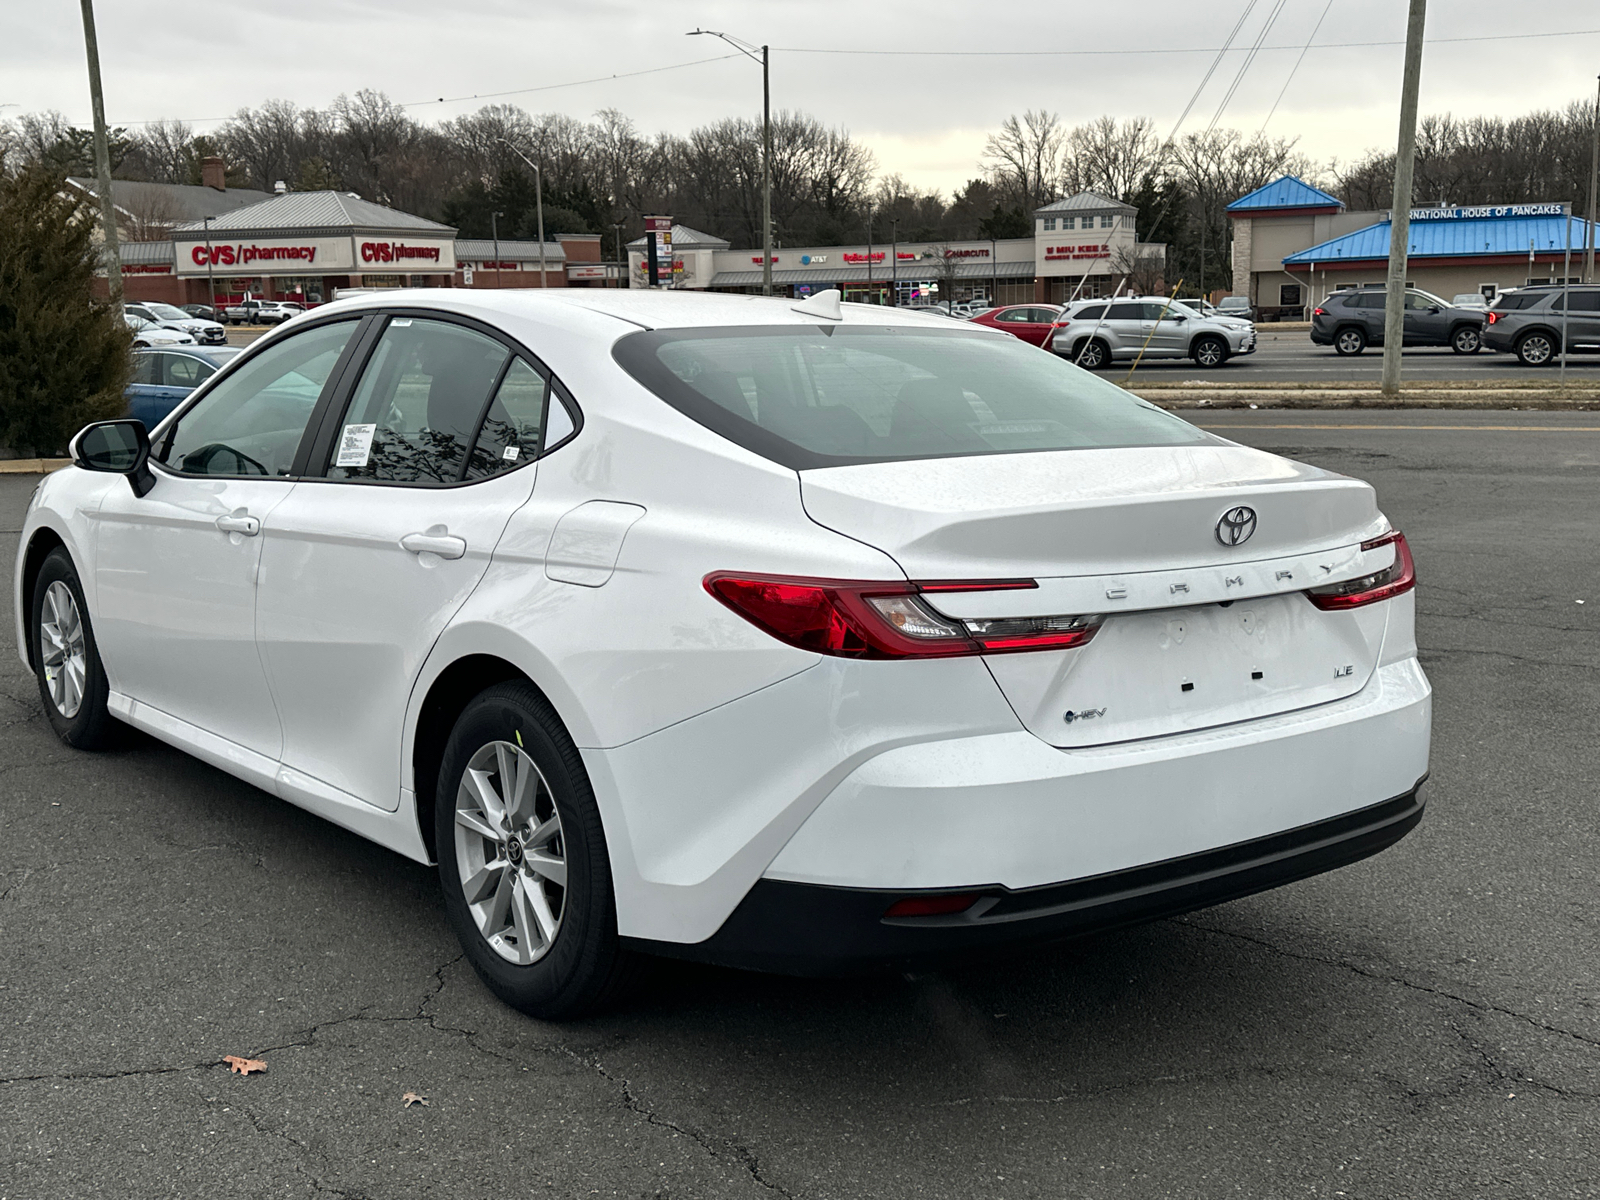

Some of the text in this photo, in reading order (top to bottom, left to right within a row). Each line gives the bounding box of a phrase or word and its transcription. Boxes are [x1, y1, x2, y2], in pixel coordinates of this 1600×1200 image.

[1388, 205, 1562, 220] IRNATIONAL HOUSE OF PANCAKES
[1078, 245, 1099, 253] KEE
[810, 255, 828, 264] AT&T
[1105, 562, 1335, 600] CAMRY
[1333, 665, 1354, 679] LE
